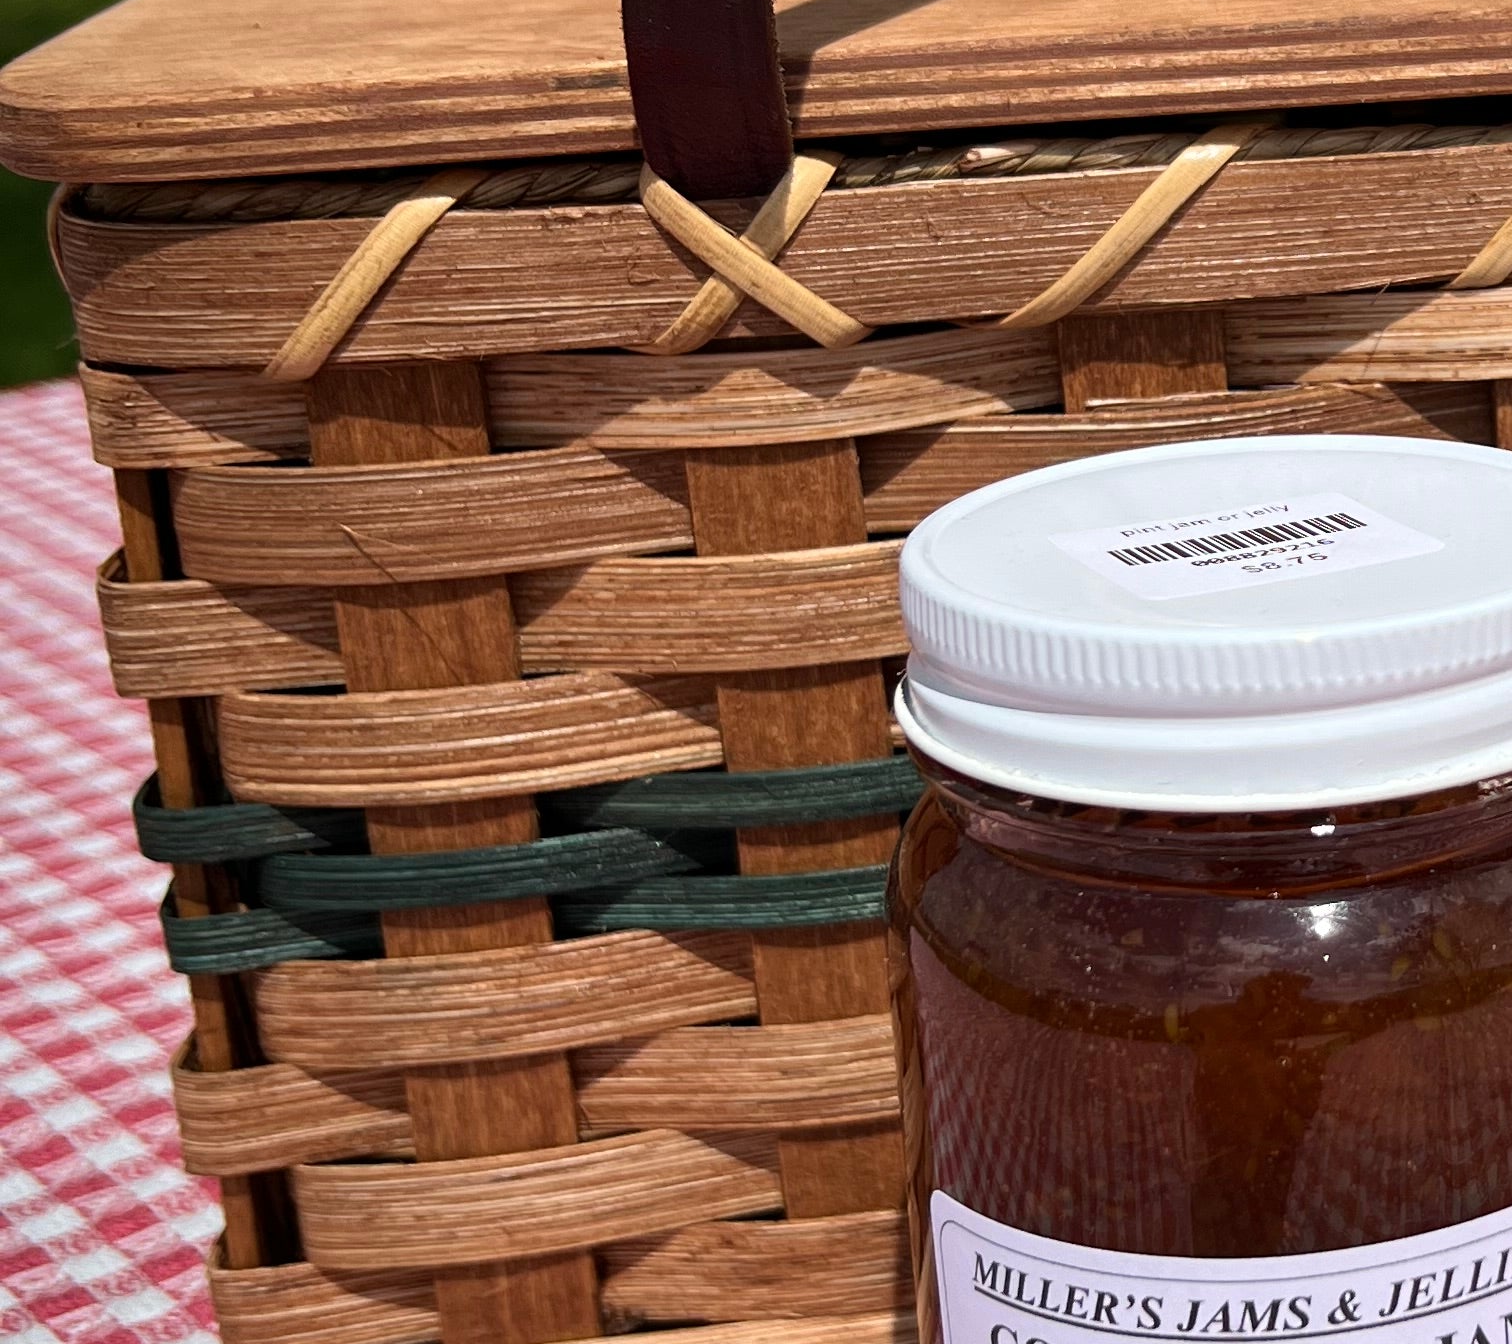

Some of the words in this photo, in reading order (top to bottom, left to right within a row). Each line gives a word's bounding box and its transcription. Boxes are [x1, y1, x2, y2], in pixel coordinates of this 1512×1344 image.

[1120, 521, 1164, 538] pint
[1169, 516, 1212, 532] jam
[1217, 513, 1240, 523] or
[1244, 504, 1290, 520] jelly
[1240, 551, 1329, 574] $8.75
[973, 1251, 1161, 1331] MILLER’S
[1176, 1296, 1311, 1334] JAMS
[1327, 1290, 1362, 1324] &
